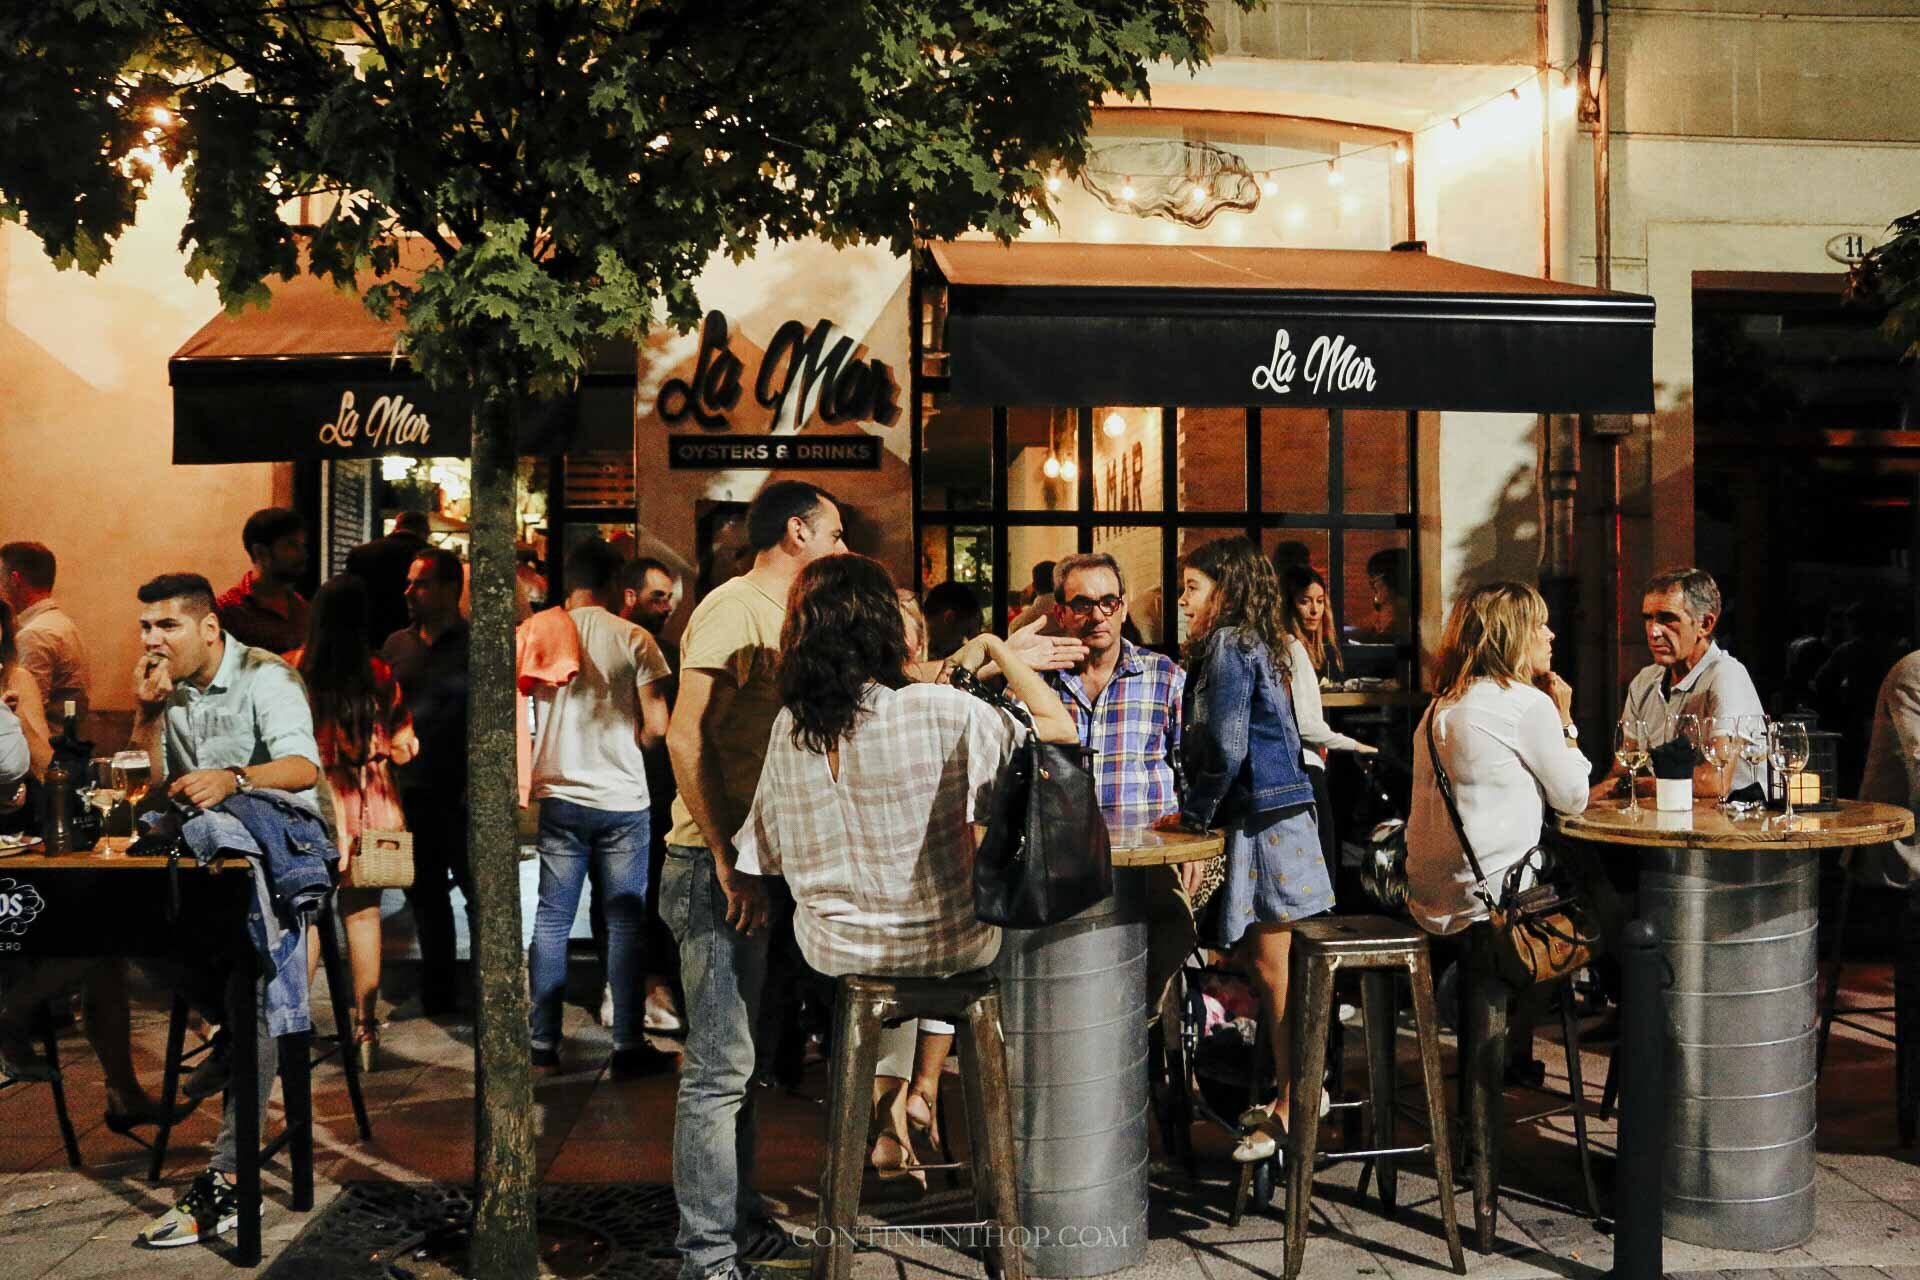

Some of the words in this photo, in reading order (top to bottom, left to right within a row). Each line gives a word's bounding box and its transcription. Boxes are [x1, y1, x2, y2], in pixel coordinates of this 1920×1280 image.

[1845, 235, 1865, 258] 11
[656, 309, 743, 431] La
[755, 318, 902, 431] Mar
[1252, 328, 1297, 394] La
[1303, 334, 1377, 395] Mar
[319, 390, 360, 447] La
[365, 395, 431, 448] Mar
[678, 444, 769, 460] OYSTERS
[775, 444, 791, 460] &
[797, 445, 871, 460] DRINKS
